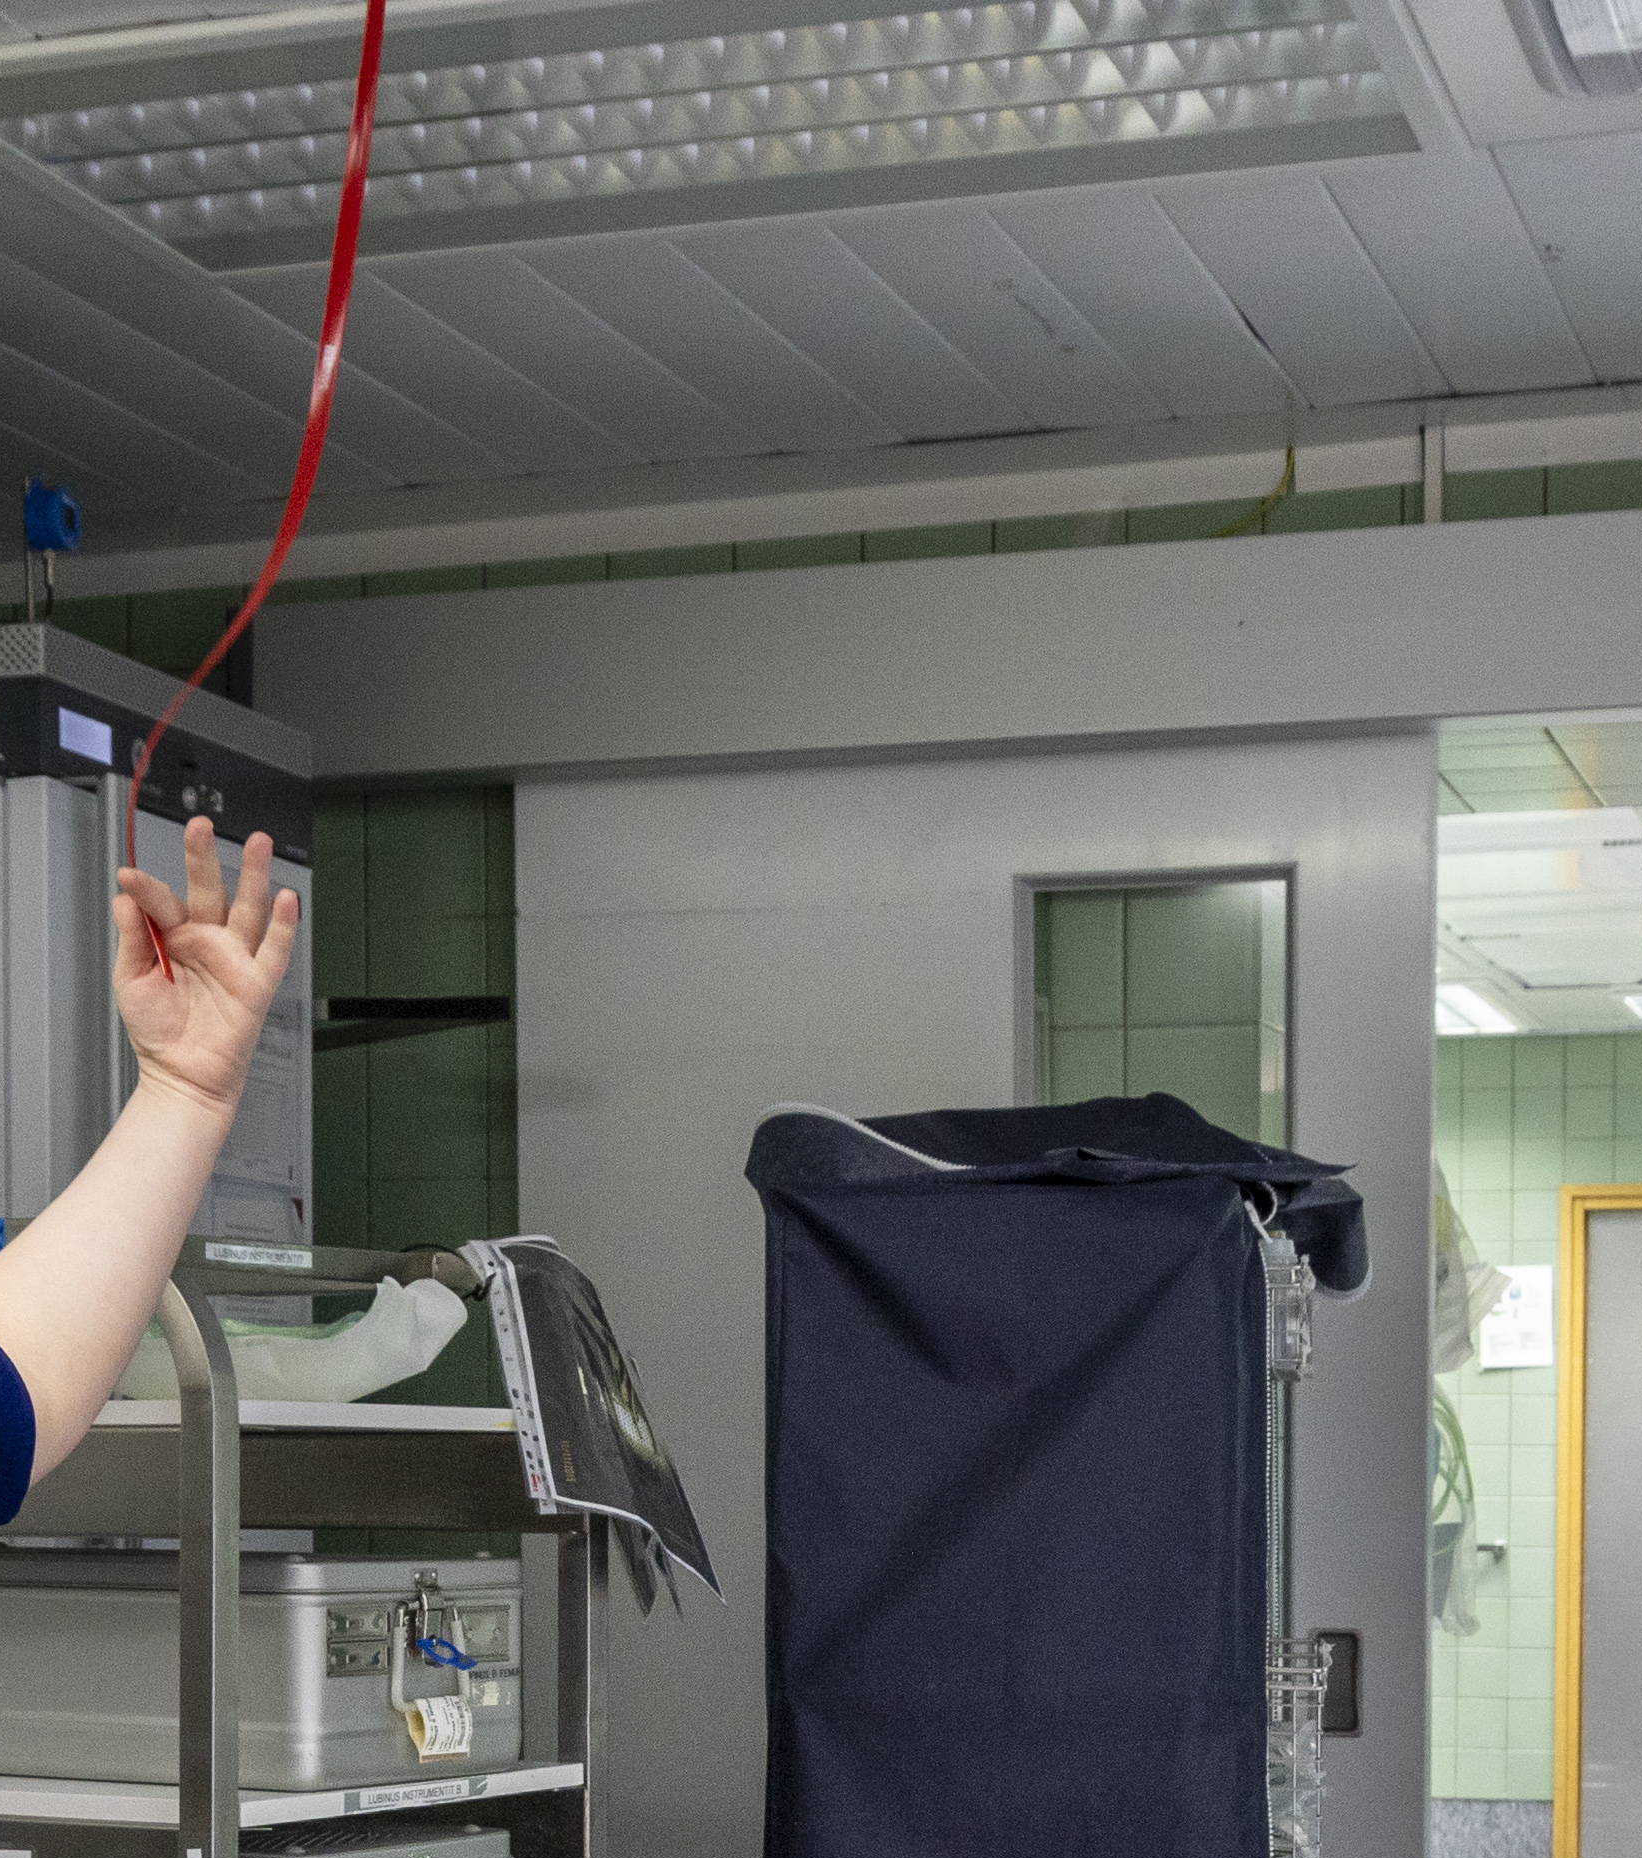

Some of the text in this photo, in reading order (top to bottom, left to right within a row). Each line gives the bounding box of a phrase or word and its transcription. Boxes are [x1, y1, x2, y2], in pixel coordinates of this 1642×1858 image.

[368, 1784, 462, 1805] LUBINUS INSTRUMENTIT B
